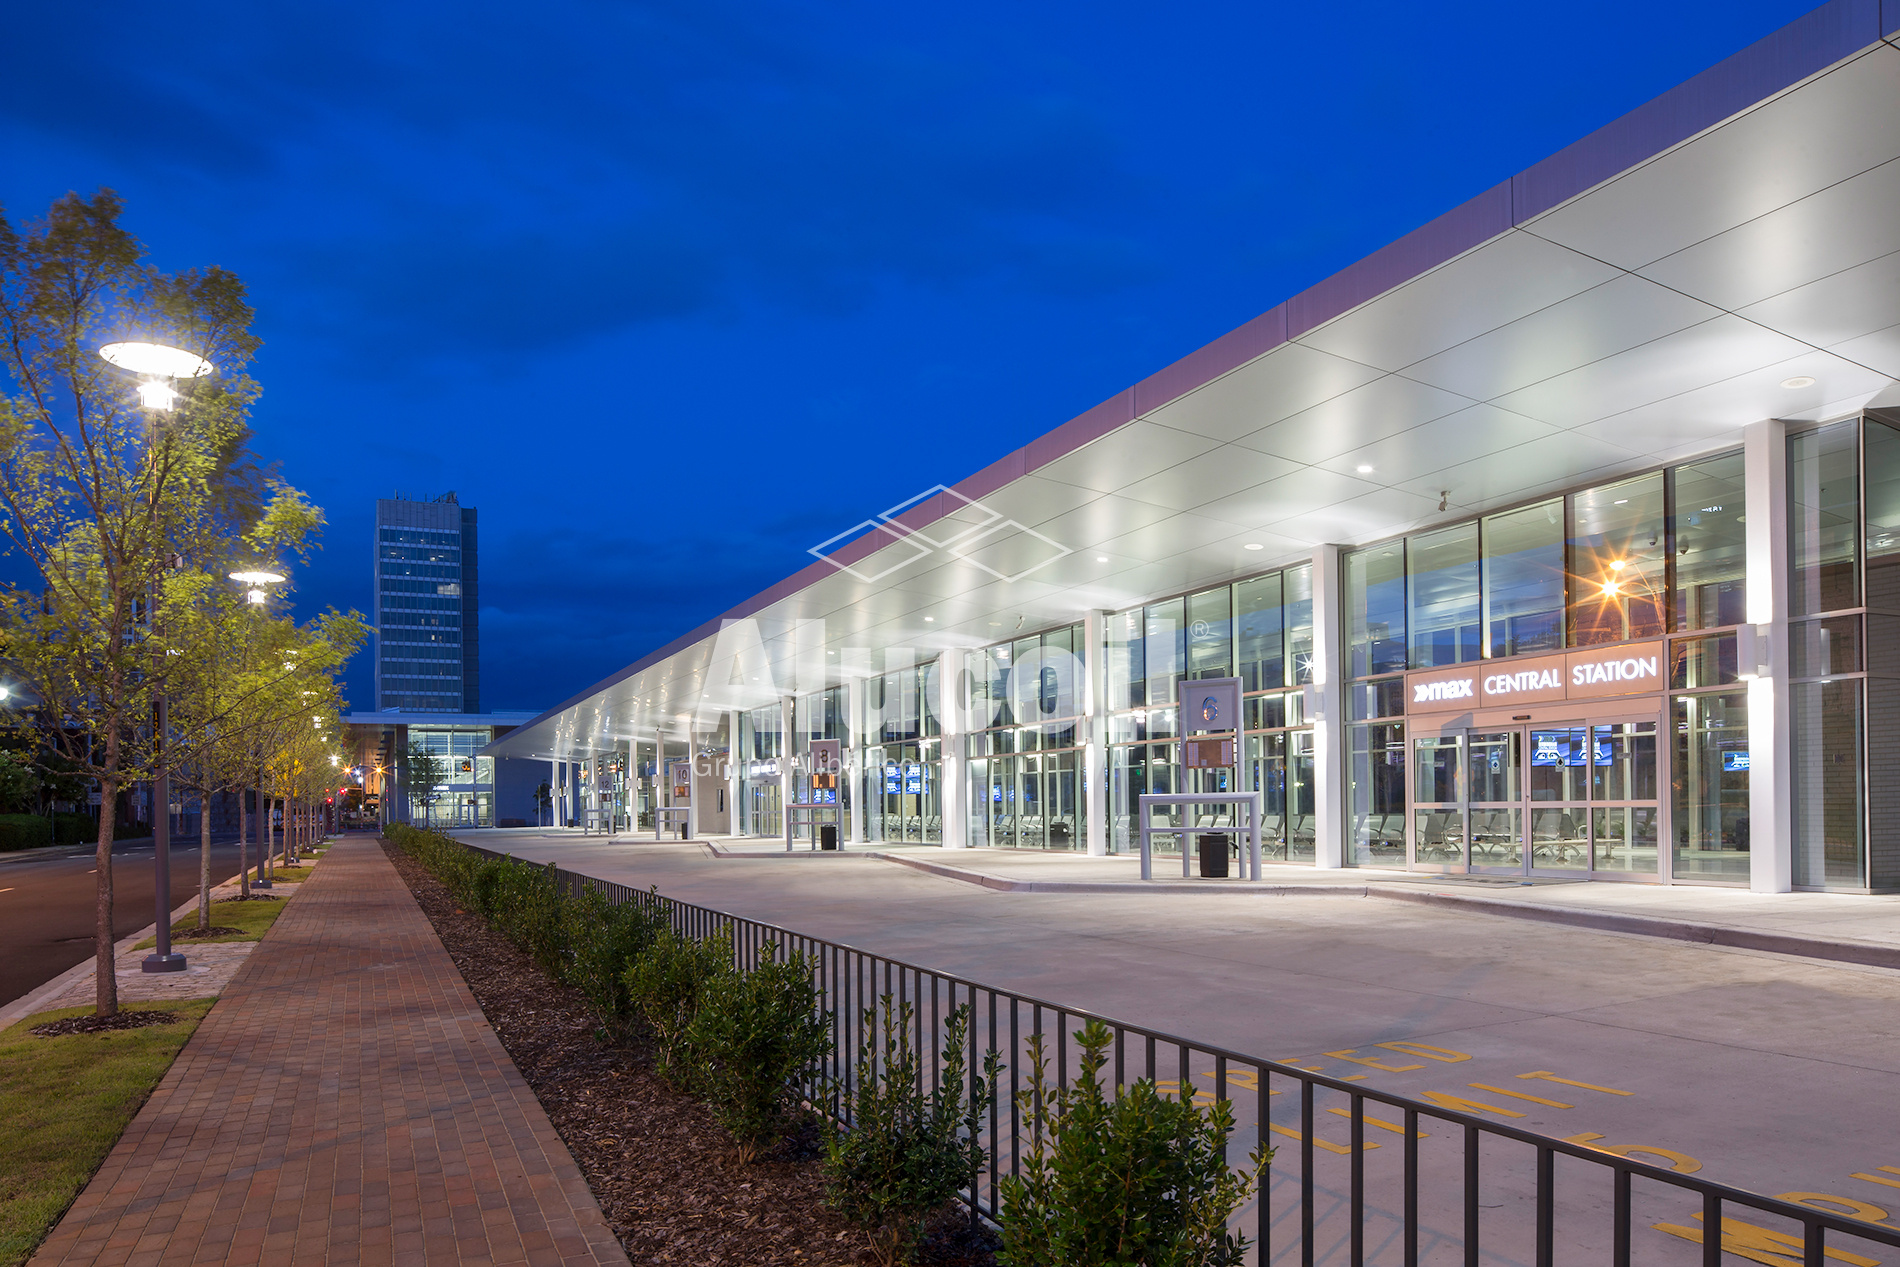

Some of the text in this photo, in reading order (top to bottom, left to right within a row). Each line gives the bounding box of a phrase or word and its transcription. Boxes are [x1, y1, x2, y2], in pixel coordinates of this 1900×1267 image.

[1428, 656, 1657, 701] max CENTRAL STATION
[1202, 696, 1218, 721] 6
[820, 748, 829, 763] 8
[677, 769, 688, 780] 10
[600, 780, 610, 789] 12
